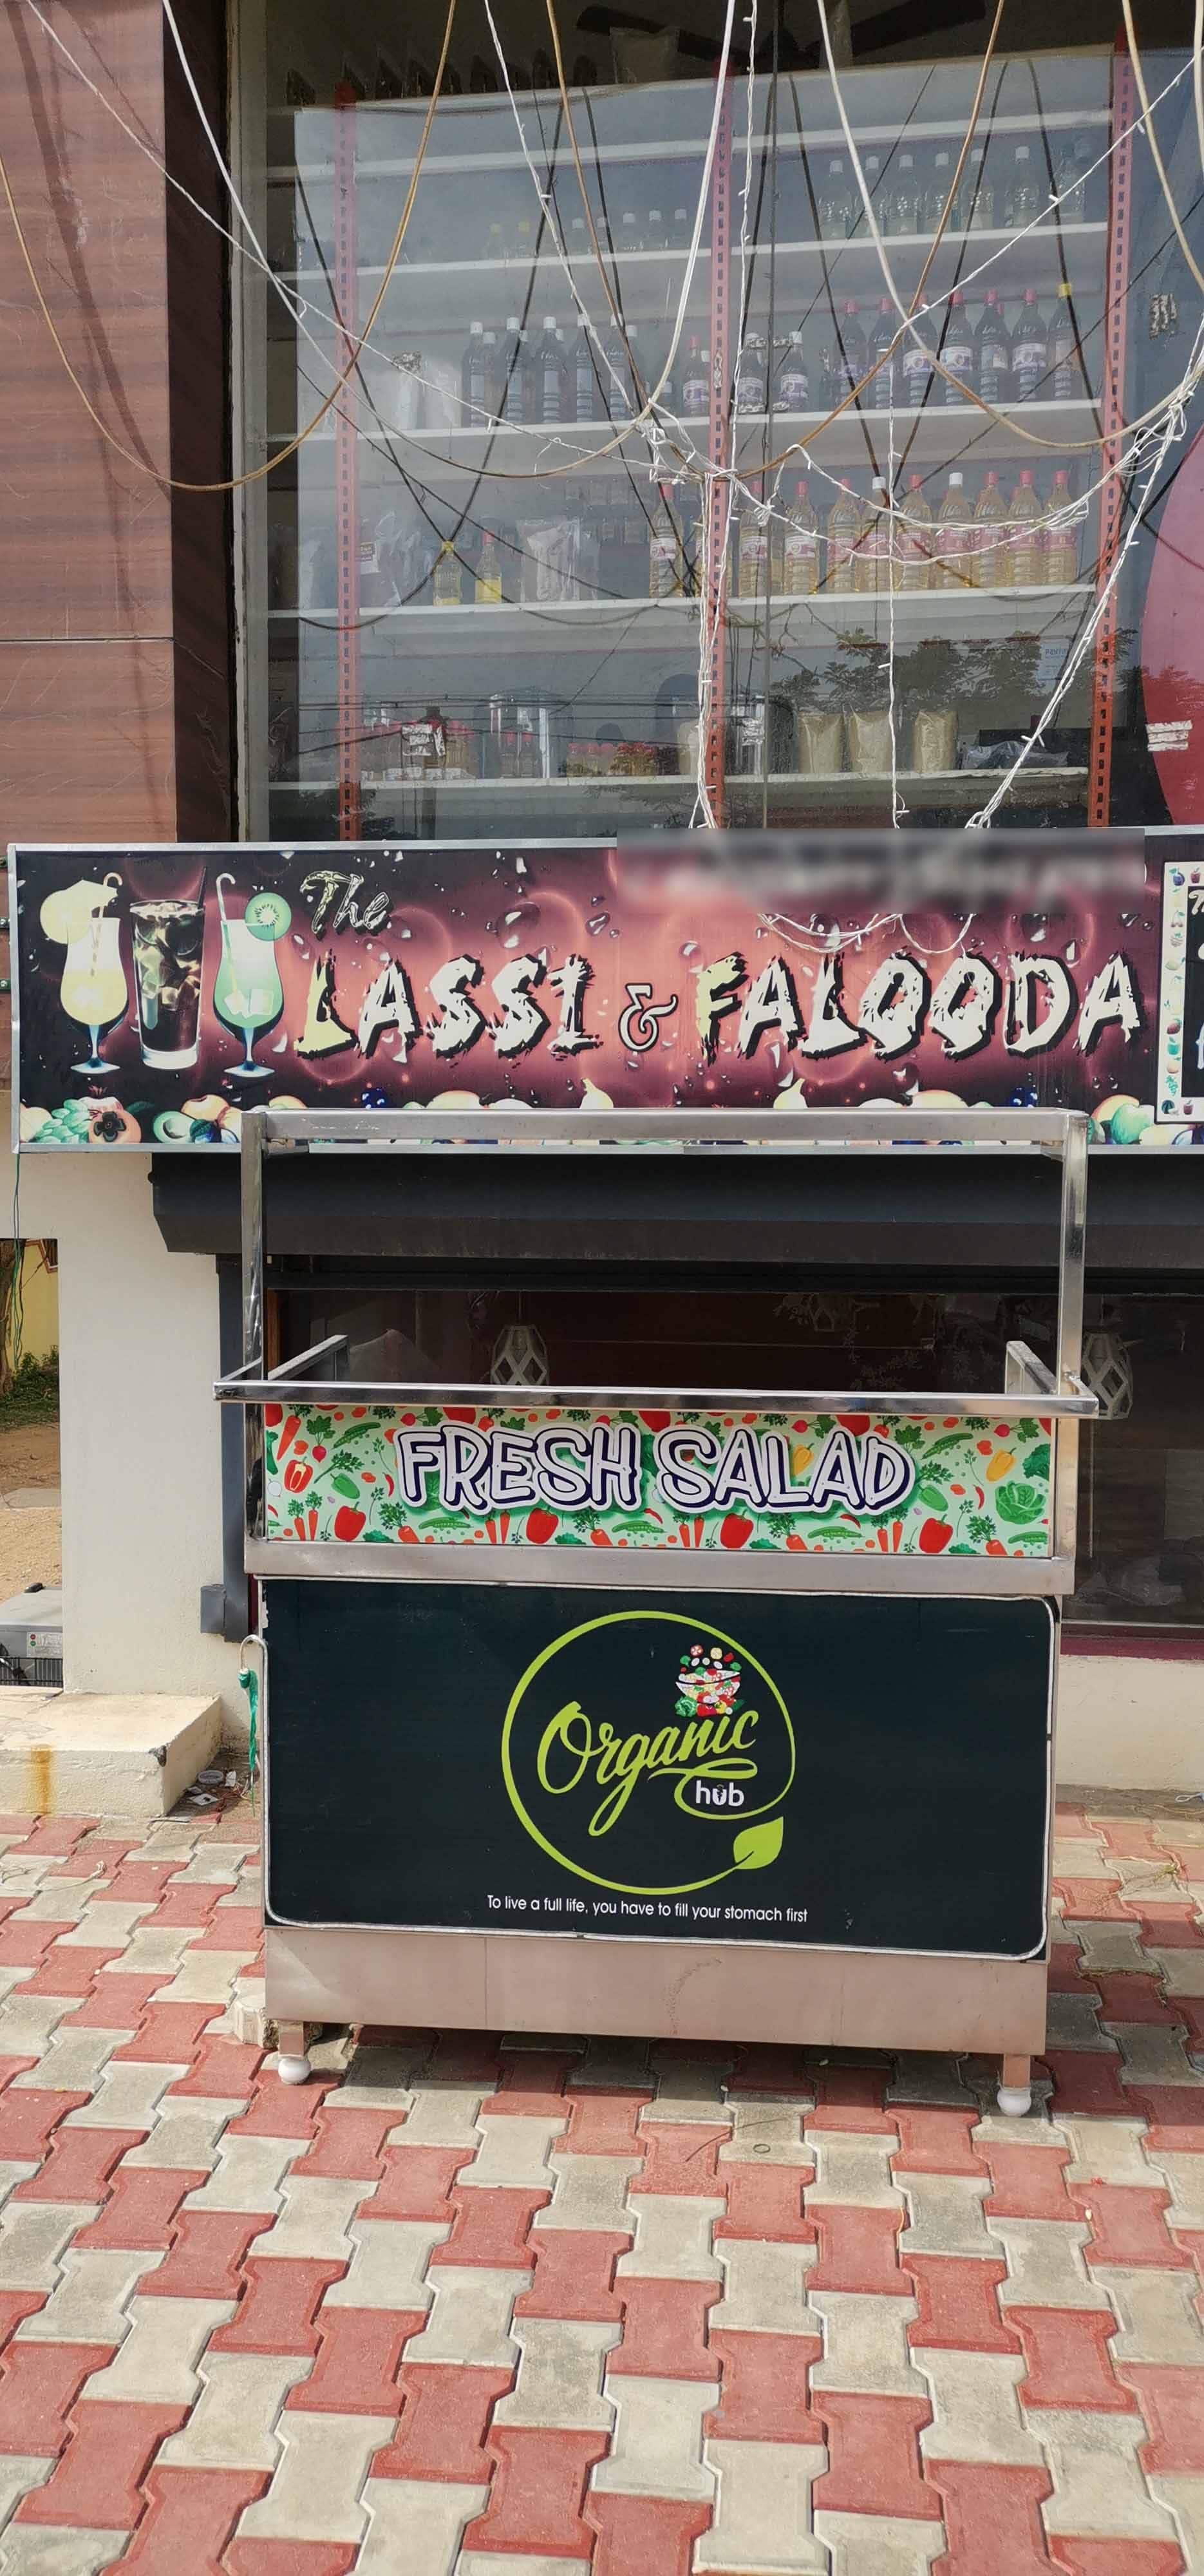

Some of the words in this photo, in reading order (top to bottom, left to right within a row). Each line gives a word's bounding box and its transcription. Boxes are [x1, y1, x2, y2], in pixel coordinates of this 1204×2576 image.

[300, 869, 392, 939] The
[294, 950, 603, 1063] LASSI
[618, 983, 679, 1052] &
[694, 951, 1146, 1066] FALOODA
[393, 1421, 641, 1515] FRESH
[654, 1425, 917, 1514] SALAD
[537, 1701, 759, 1837] Organic
[695, 1780, 744, 1807] hub
[487, 1895, 501, 1909] To
[505, 1895, 527, 1910] live
[531, 1899, 540, 1911] a
[543, 1897, 561, 1911] full
[566, 1899, 588, 1914] life,
[592, 1902, 617, 1916] you
[621, 1900, 654, 1915] have
[658, 1902, 671, 1917] to
[675, 1903, 688, 1917] fill
[692, 1906, 721, 1920] your
[724, 1906, 782, 1921] stomach
[786, 1908, 807, 1922] first
